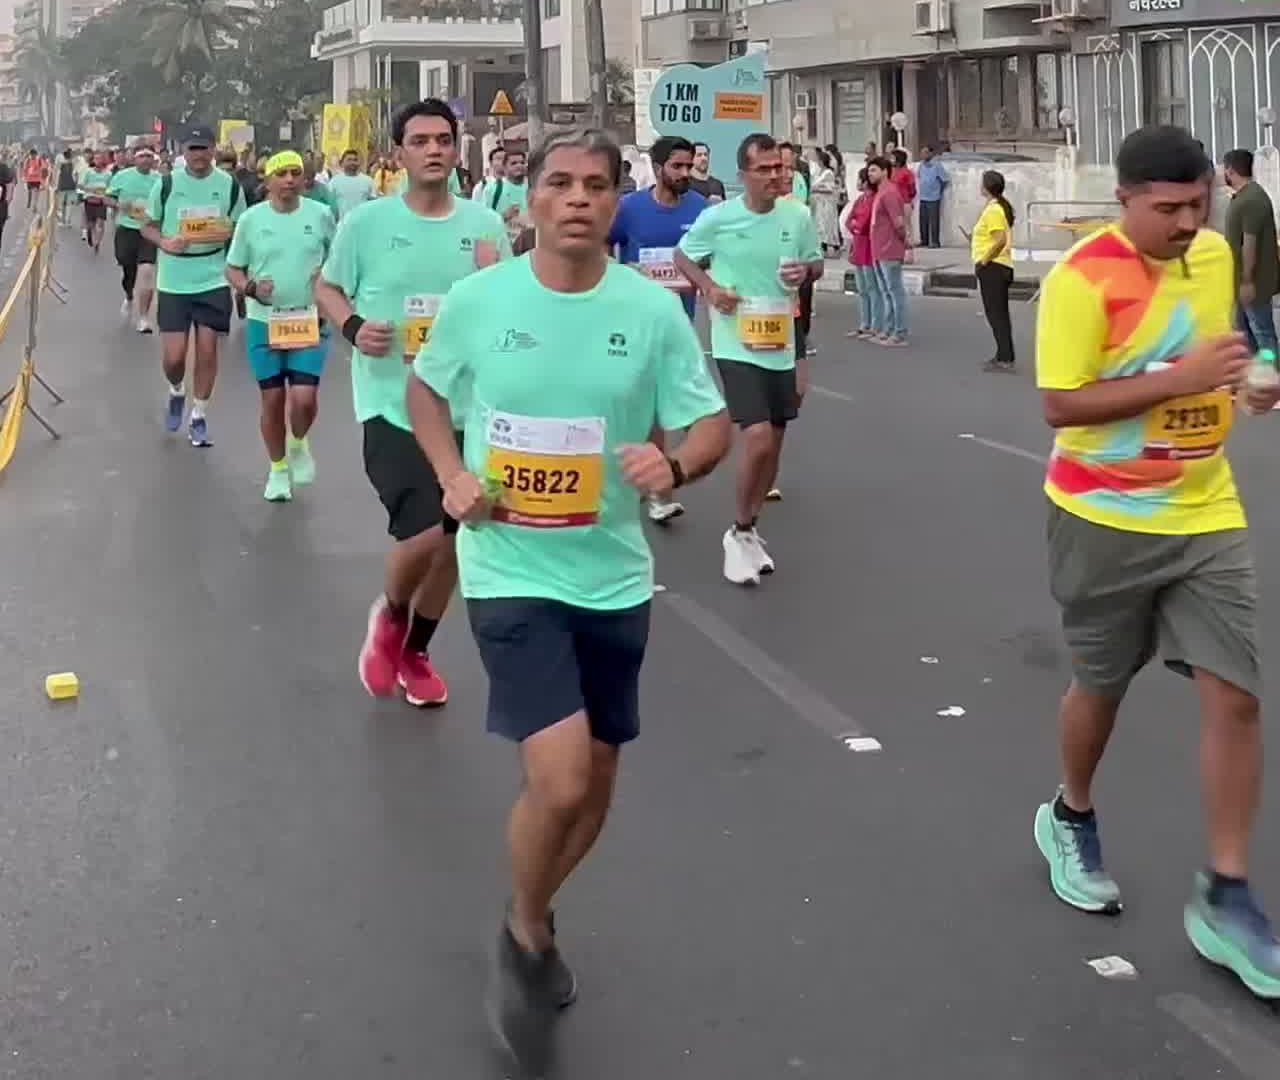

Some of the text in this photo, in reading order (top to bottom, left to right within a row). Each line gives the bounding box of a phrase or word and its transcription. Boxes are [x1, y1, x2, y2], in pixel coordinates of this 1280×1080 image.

[665, 83, 699, 102] 1 KM
[659, 104, 678, 123] TO
[681, 105, 701, 124] GO
[502, 464, 580, 495] 35822
